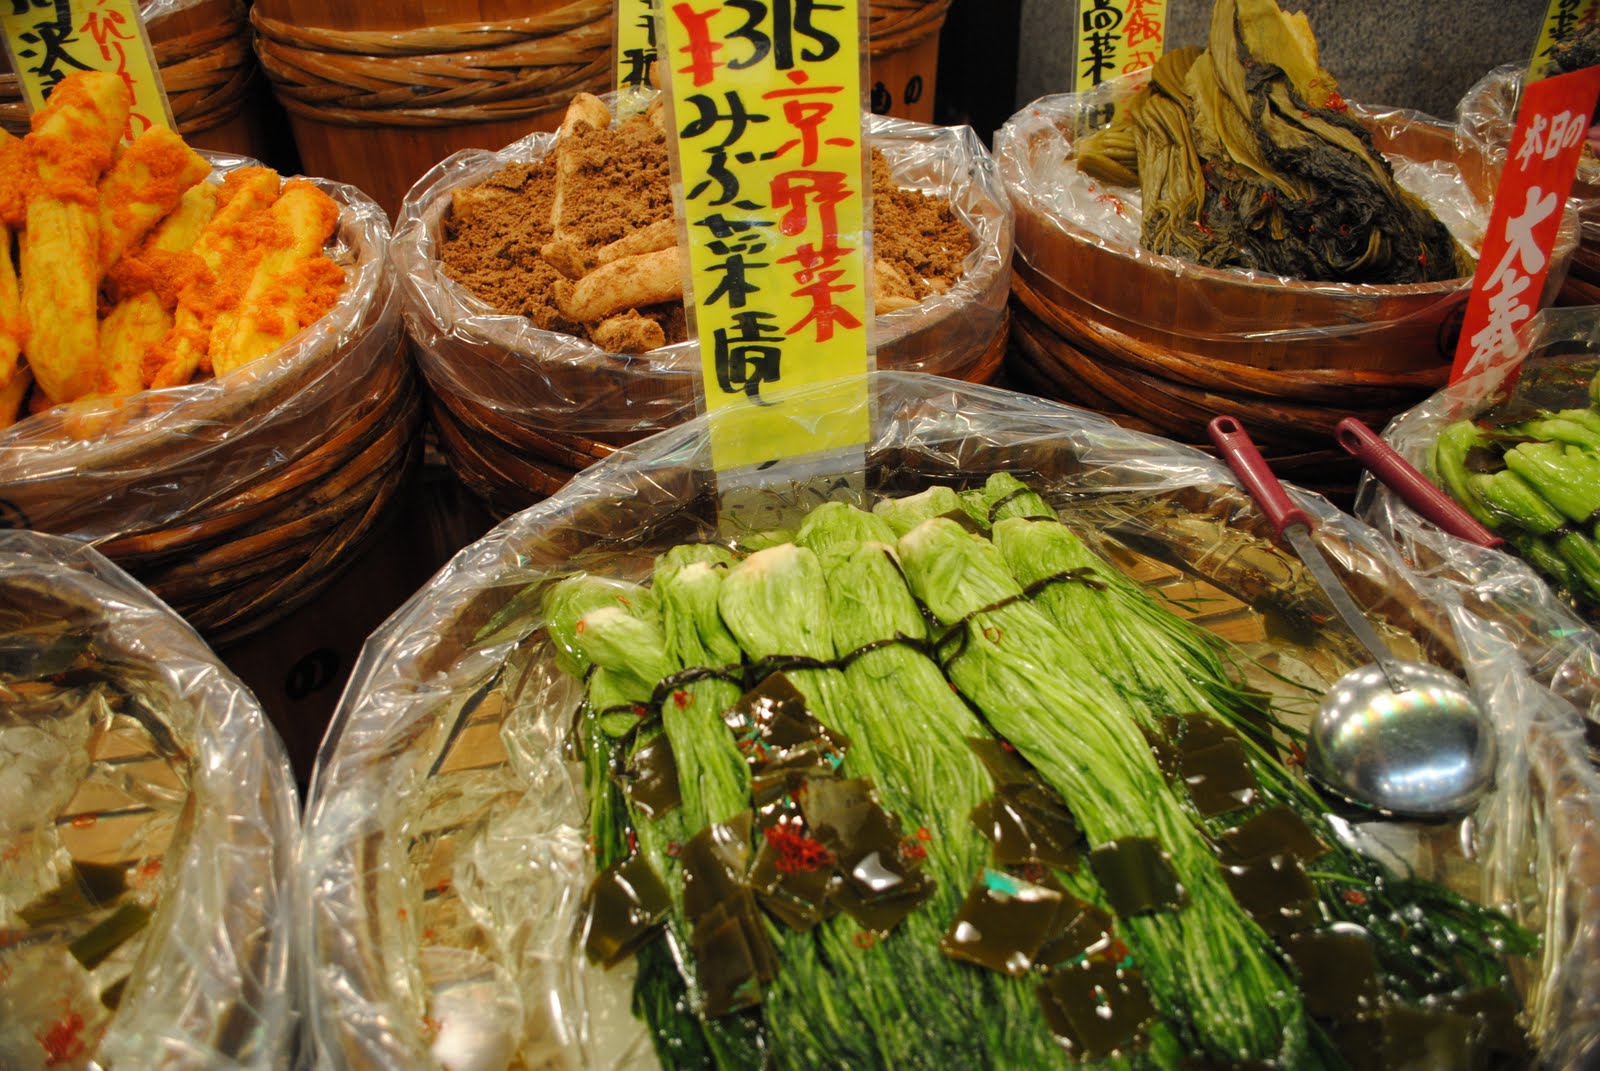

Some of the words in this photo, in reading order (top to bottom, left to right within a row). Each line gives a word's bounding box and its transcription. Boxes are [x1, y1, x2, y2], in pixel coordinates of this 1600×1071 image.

[761, 70, 863, 344] 京野菜
[1515, 110, 1586, 172] 本日の
